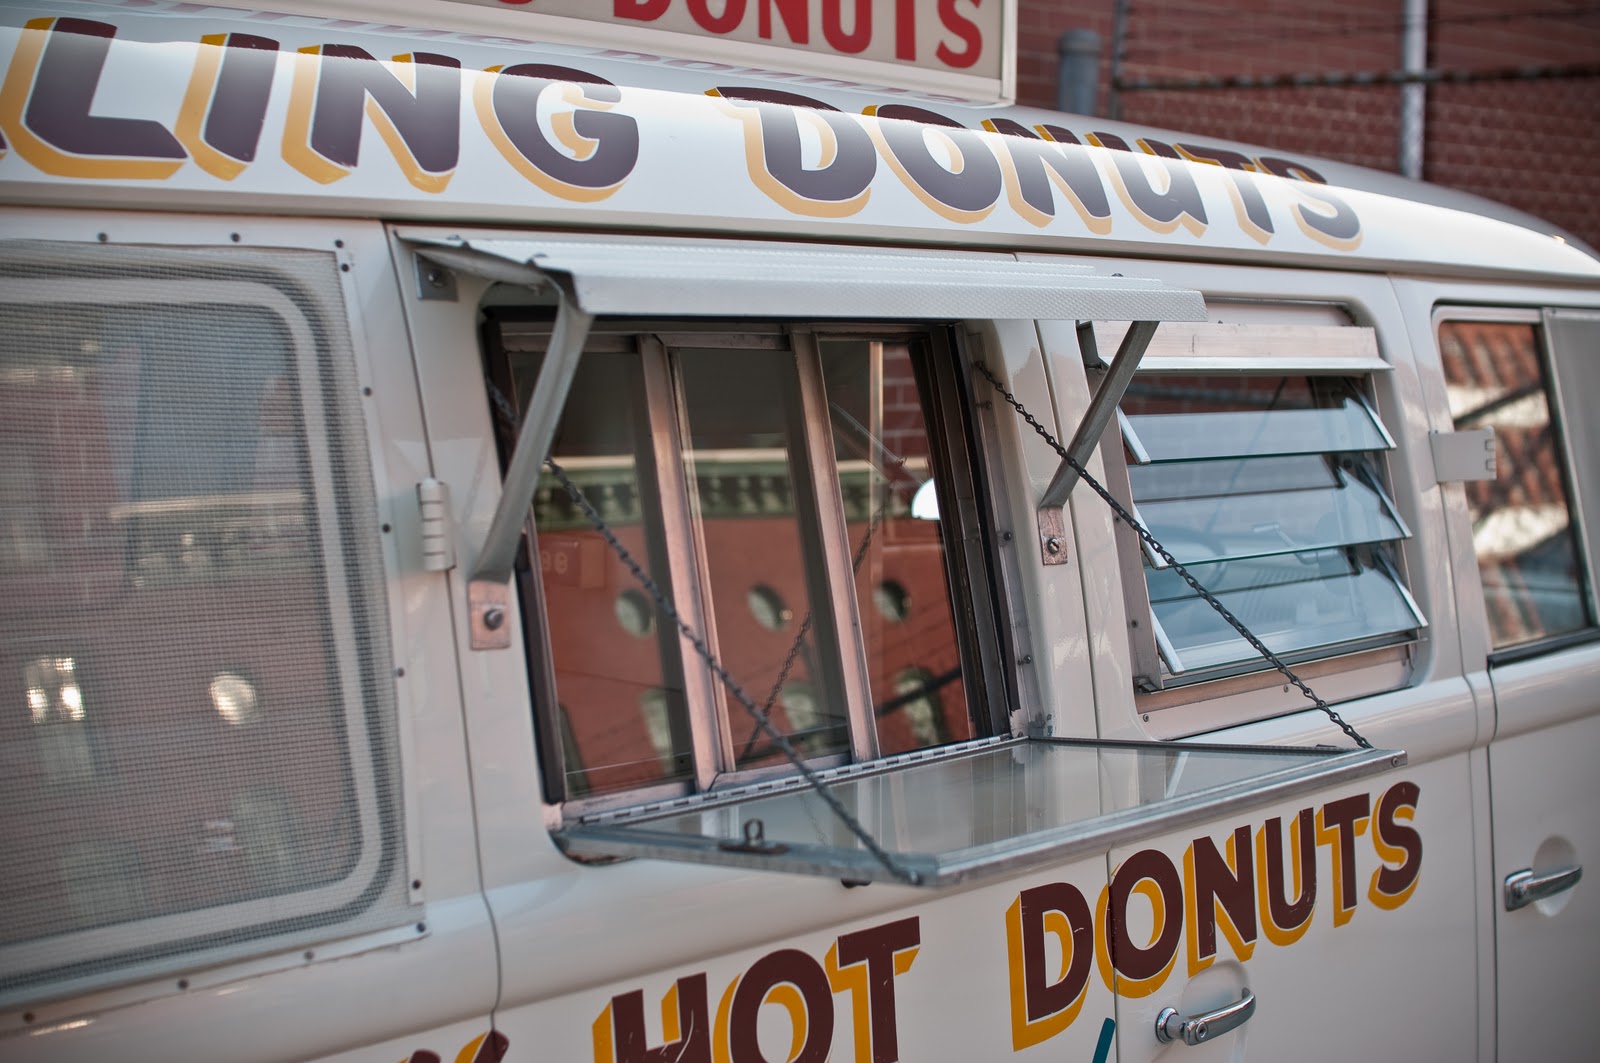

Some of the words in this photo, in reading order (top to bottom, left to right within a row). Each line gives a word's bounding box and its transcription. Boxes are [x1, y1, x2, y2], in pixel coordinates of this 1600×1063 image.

[0, 16, 640, 203] LING
[703, 86, 1364, 252] DONUTS
[614, 0, 983, 69] NUTS
[592, 915, 921, 1063] HOT
[1005, 780, 1424, 1052] DONUTS
